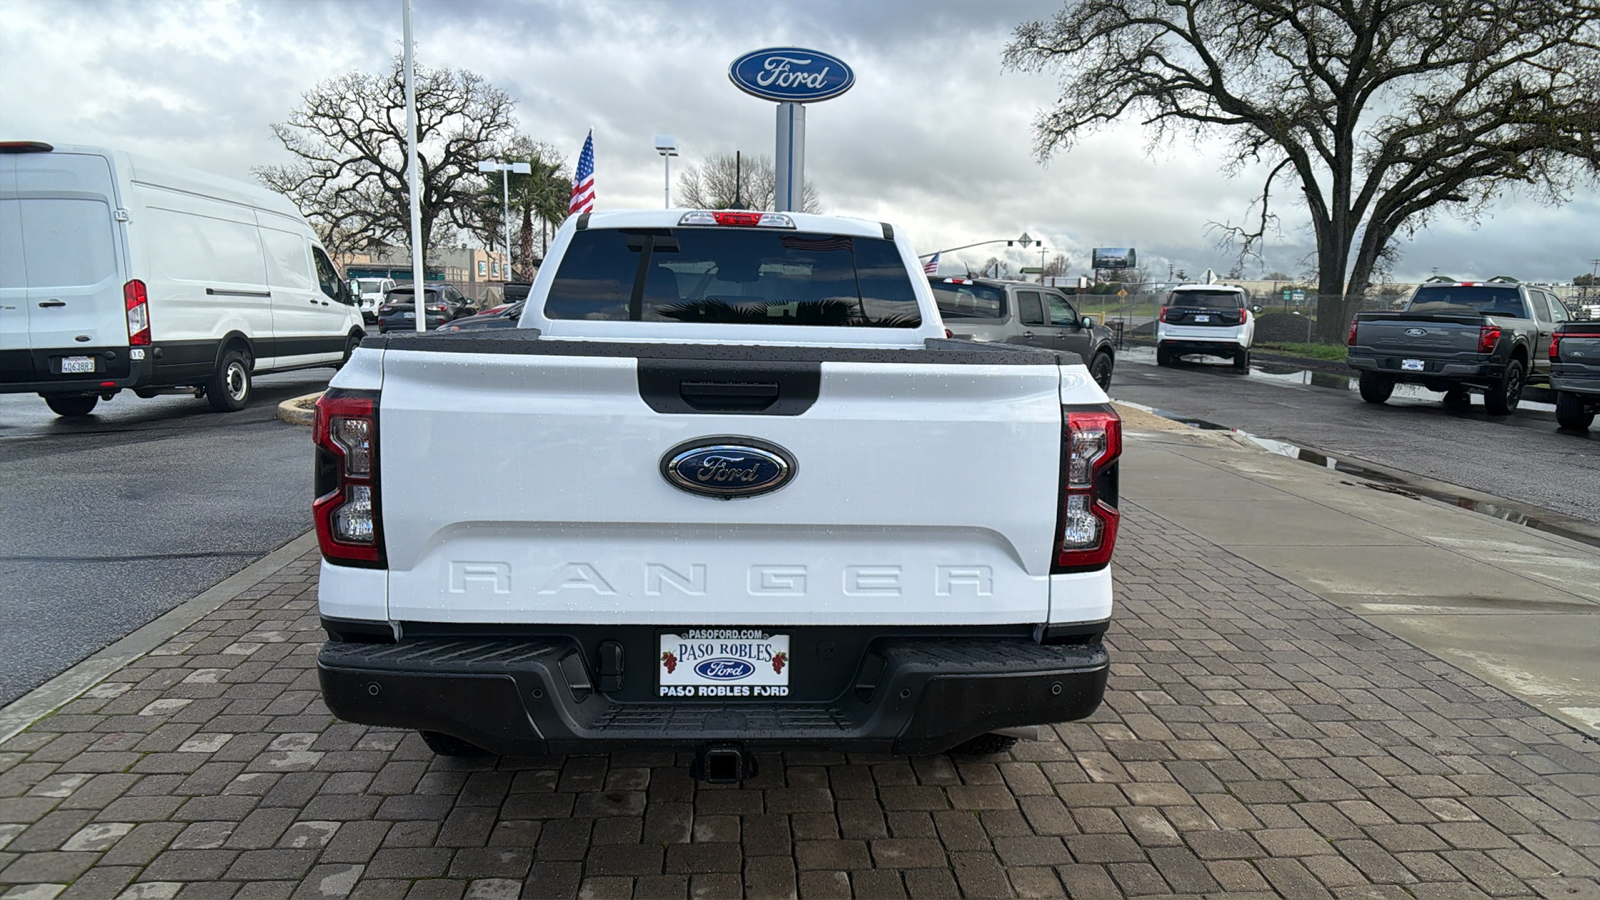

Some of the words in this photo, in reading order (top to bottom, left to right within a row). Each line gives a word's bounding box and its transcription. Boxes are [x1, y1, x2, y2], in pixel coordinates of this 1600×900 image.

[757, 56, 830, 89] Ford
[696, 455, 760, 482] Ford
[448, 560, 993, 596] RANGER
[688, 629, 763, 640] PASOFORD.COM
[678, 643, 714, 663] PASO
[719, 643, 773, 663] ROBLES
[706, 660, 744, 677] Ford
[659, 686, 695, 697] PASO
[698, 686, 750, 697] ROBLES
[753, 686, 789, 697] FORD
